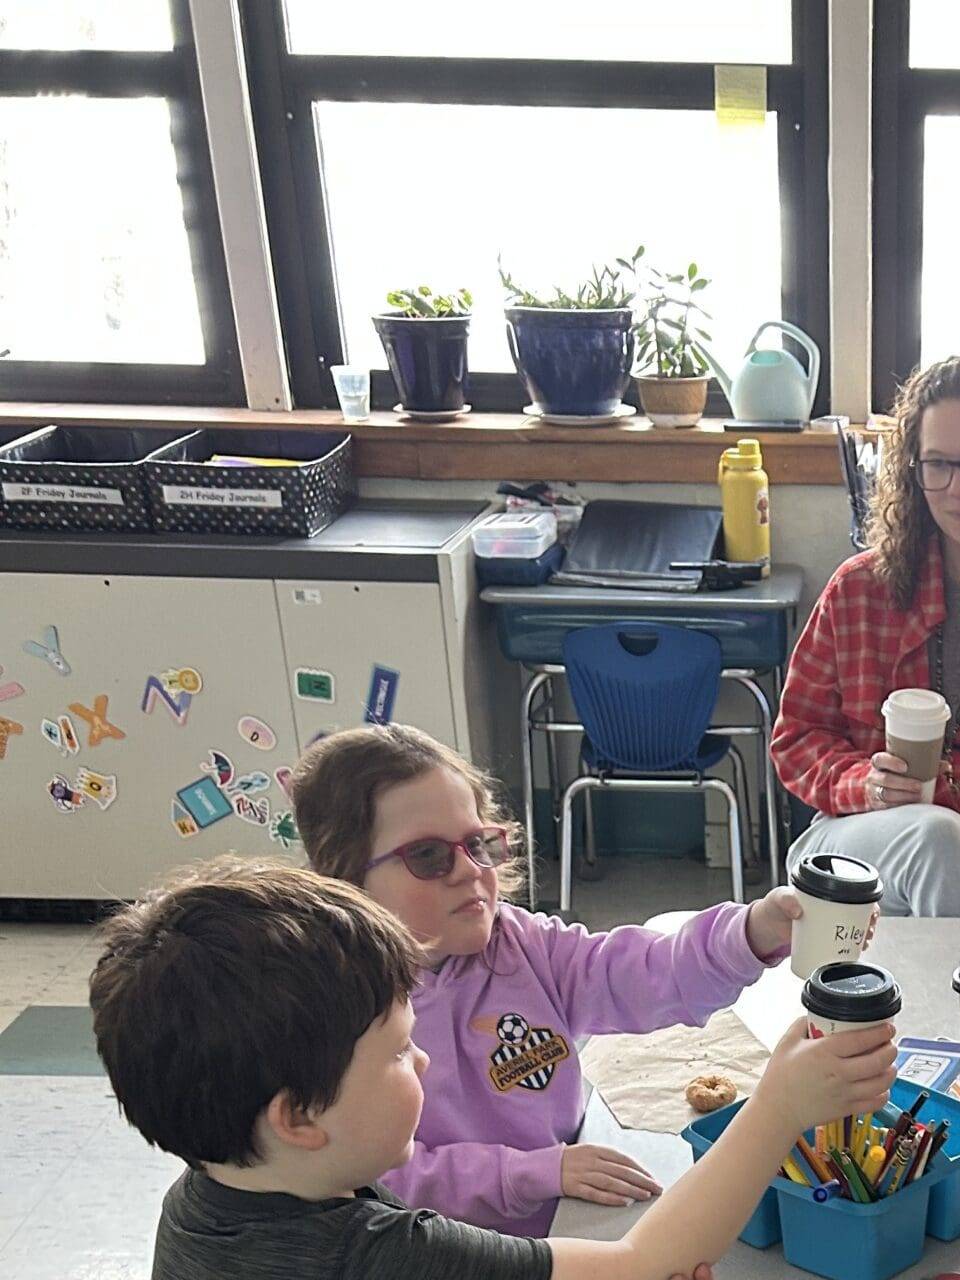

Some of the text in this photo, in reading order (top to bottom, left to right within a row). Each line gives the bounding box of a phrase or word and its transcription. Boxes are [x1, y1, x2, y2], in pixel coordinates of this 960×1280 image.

[36, 488, 65, 499] Friday
[69, 489, 107, 500] Journals
[196, 491, 225, 503] Friday
[229, 492, 267, 503] Journals
[834, 925, 865, 945] Riley
